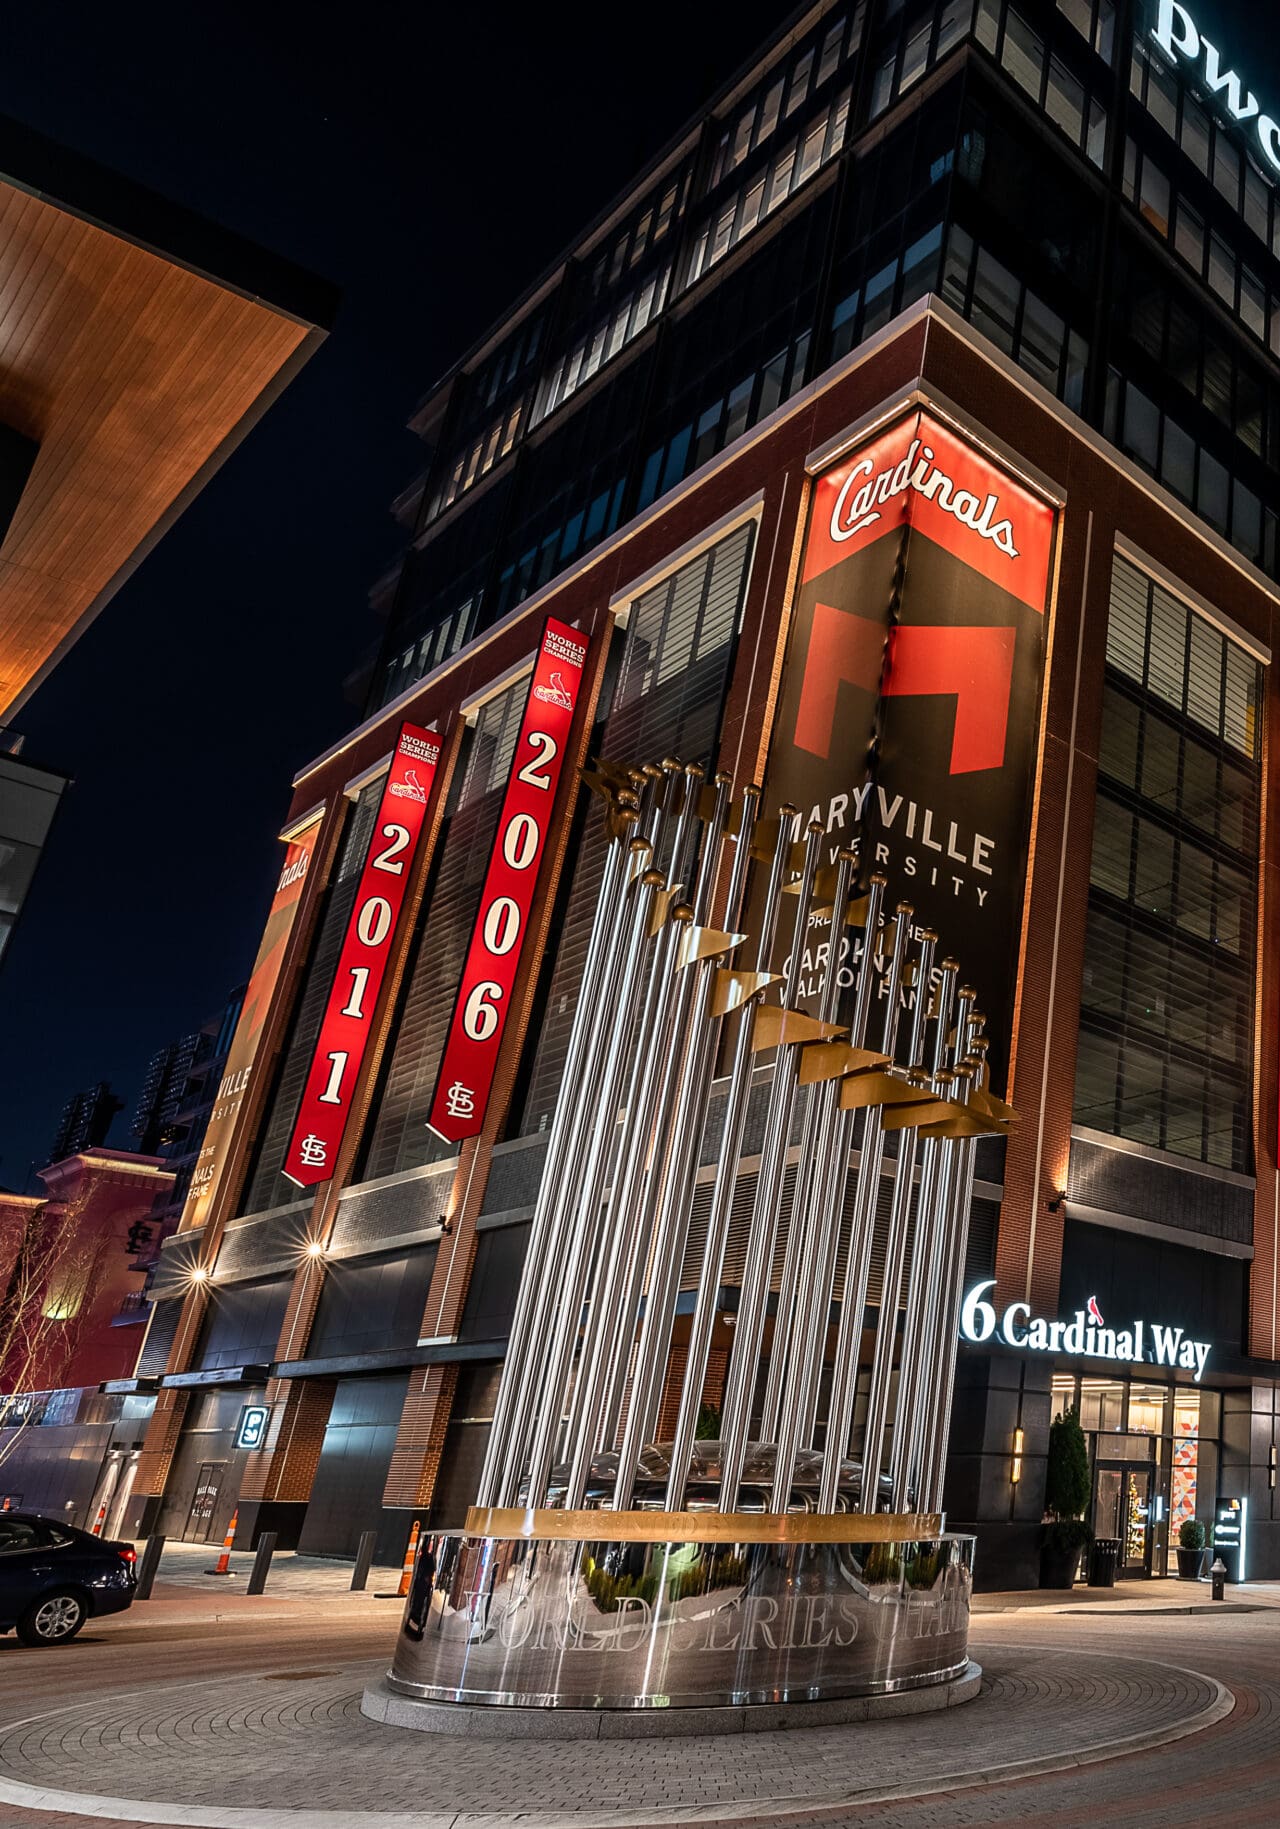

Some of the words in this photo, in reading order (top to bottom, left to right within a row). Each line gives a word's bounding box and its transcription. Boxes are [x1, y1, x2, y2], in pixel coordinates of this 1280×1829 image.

[829, 439, 1020, 560] Cardinals
[544, 639, 583, 663] SERIES
[546, 630, 586, 655] WORLD
[543, 646, 583, 669] CHAMPIONS
[400, 741, 438, 760] SERIES
[402, 733, 440, 753] WORLD
[398, 748, 436, 766] CHAMPIONS
[790, 837, 988, 907] VERSITY
[463, 731, 558, 1042] 2006
[319, 823, 412, 1105] 2011
[961, 1280, 998, 1342] 6
[1003, 1302, 1144, 1363] Cardinal
[1151, 1324, 1211, 1382] Way
[248, 1413, 262, 1428] P
[668, 1595, 859, 1652] SERIES
